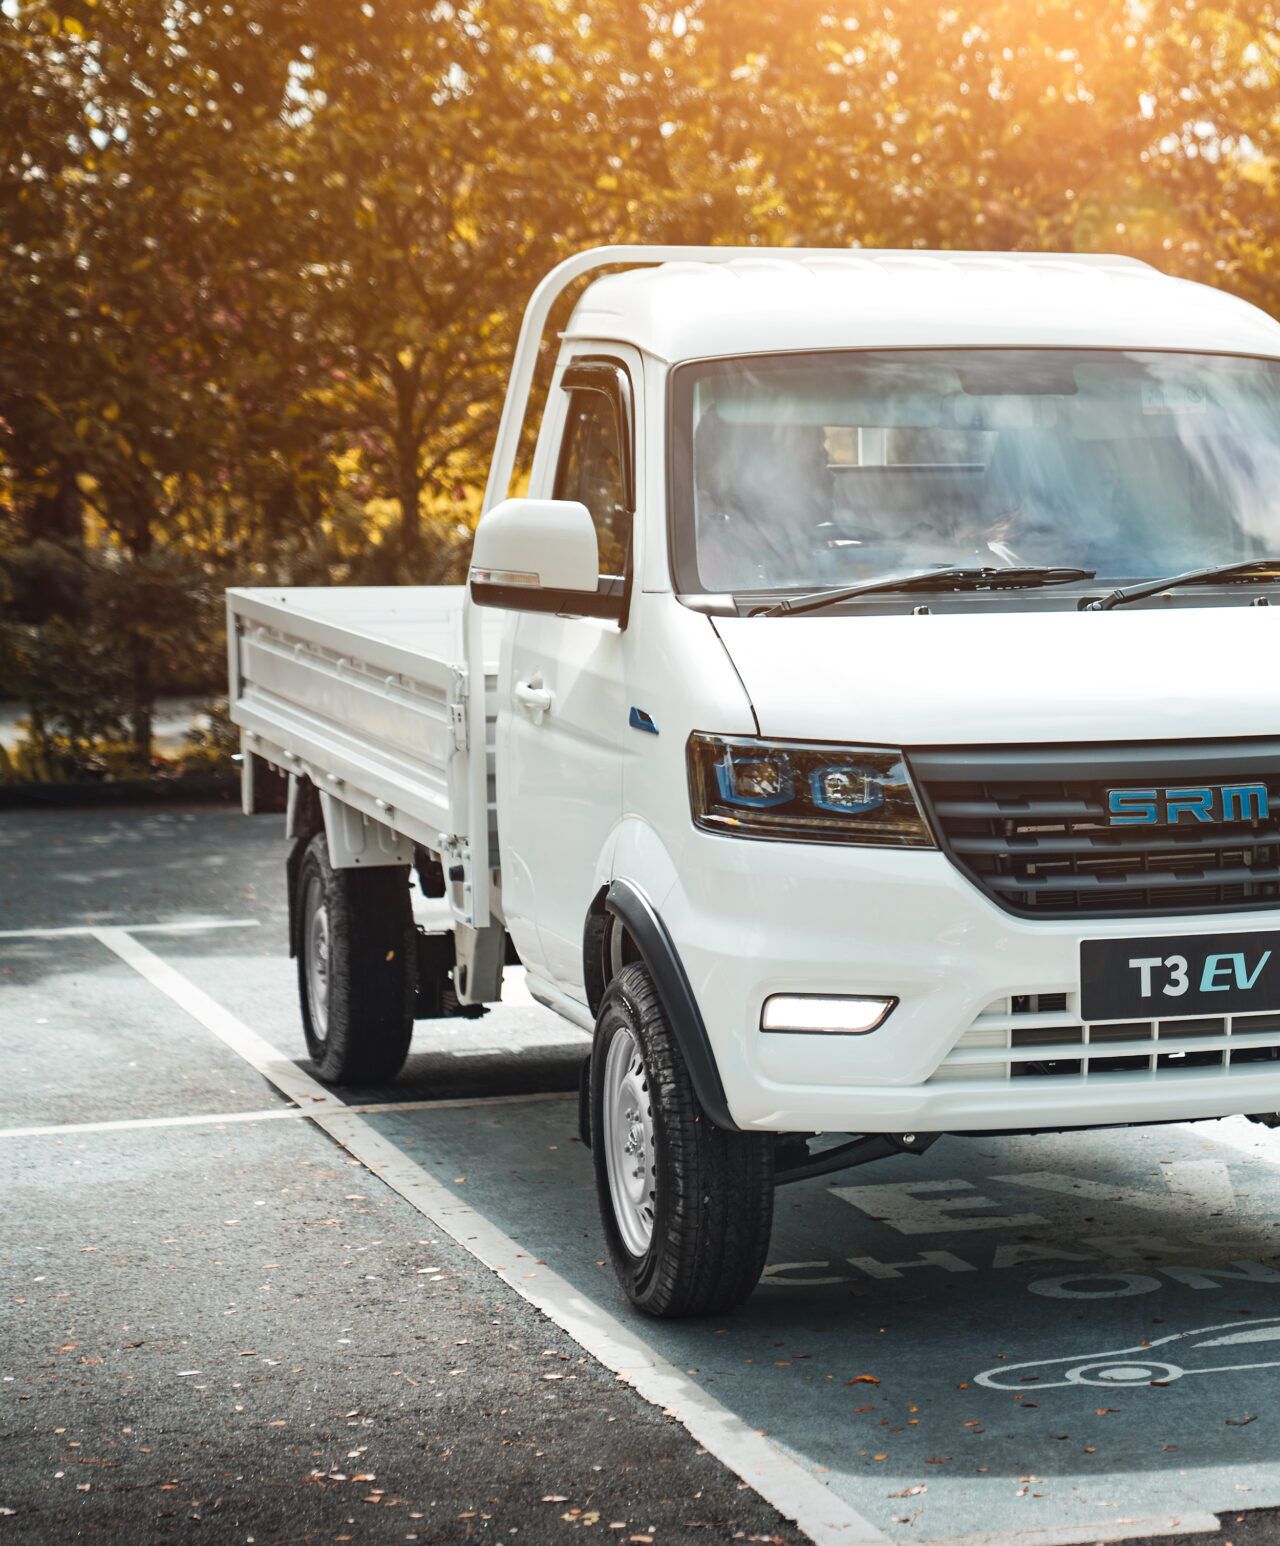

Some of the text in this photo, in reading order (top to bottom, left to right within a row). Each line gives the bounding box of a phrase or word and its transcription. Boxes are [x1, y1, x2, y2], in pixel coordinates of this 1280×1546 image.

[1108, 782, 1269, 826] SRM
[1128, 950, 1272, 998] T3 EV
[827, 1159, 1238, 1236] EV
